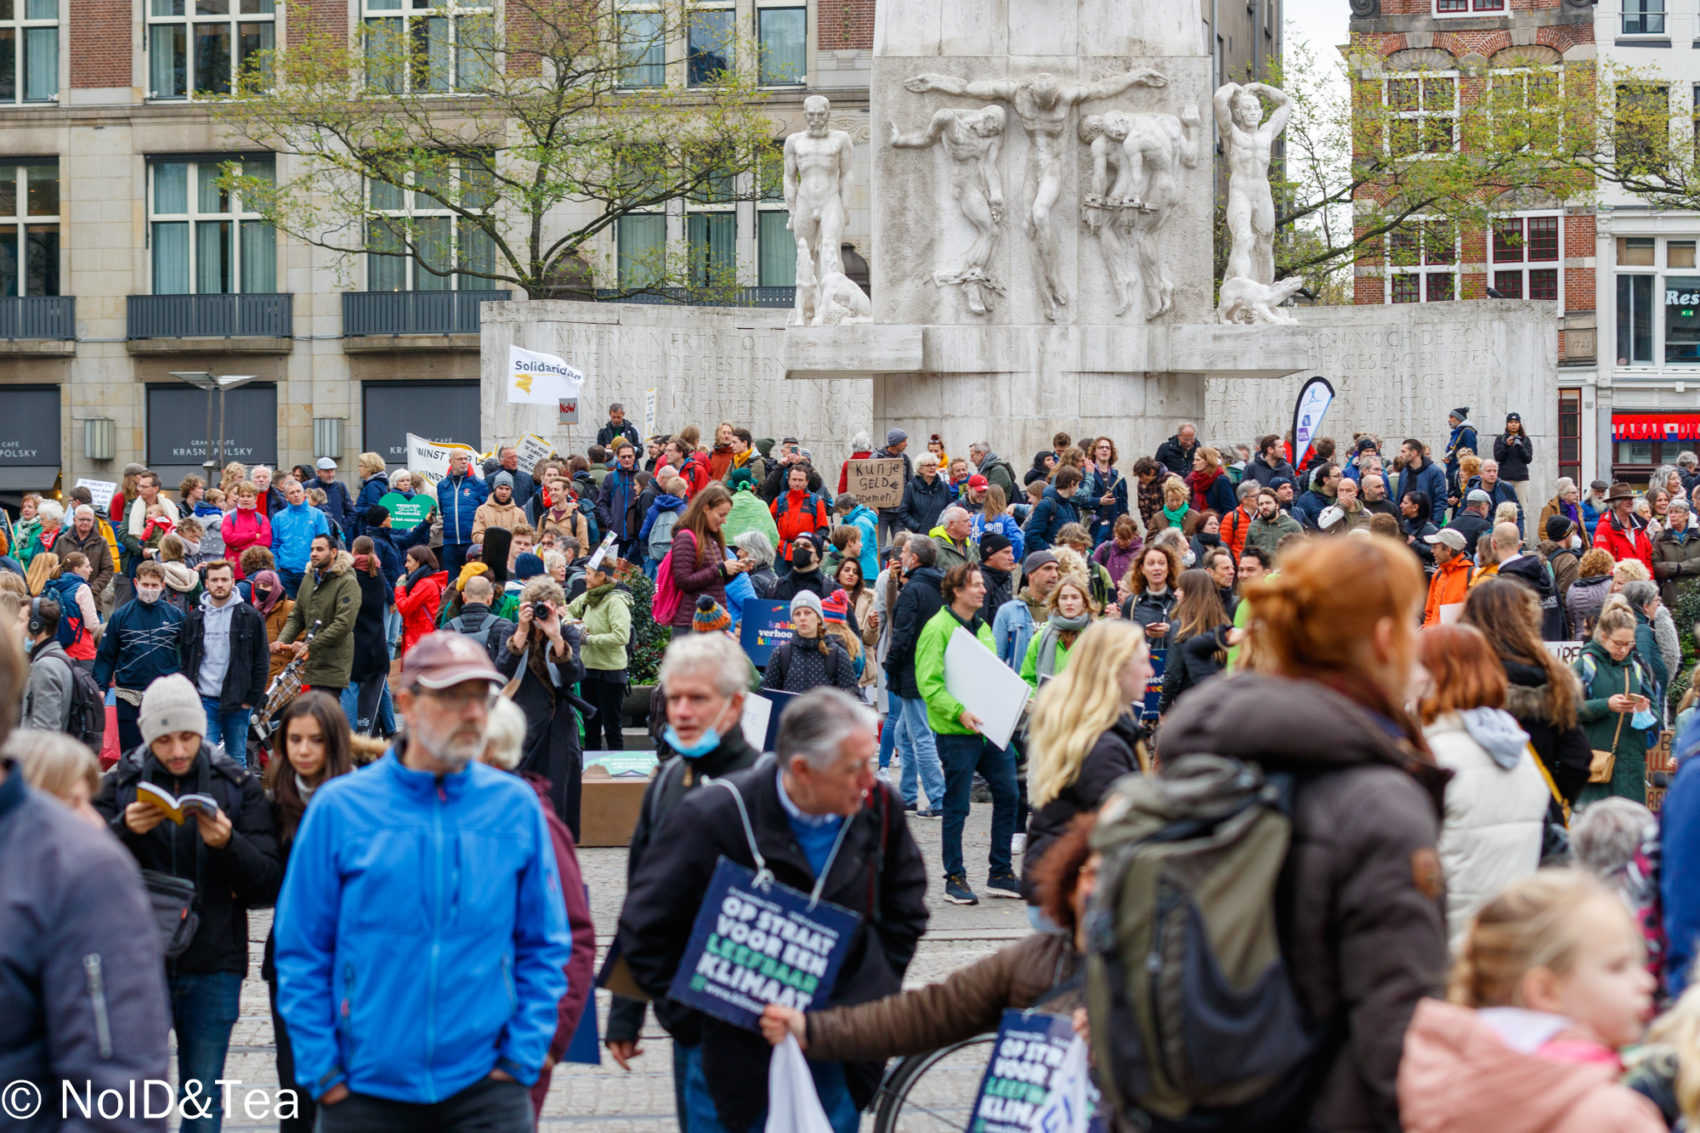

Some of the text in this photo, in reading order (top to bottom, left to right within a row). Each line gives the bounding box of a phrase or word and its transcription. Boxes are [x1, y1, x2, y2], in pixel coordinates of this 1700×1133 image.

[1664, 290, 1700, 305] Res
[1421, 329, 1444, 346] DE
[1613, 419, 1668, 440] TABAK
[172, 447, 253, 456] KRASNPLSKY
[416, 446, 447, 461] WINST
[757, 636, 791, 646] klima
[721, 896, 758, 922] OP
[756, 909, 837, 957] STRAAT
[716, 913, 784, 959] VOOR
[782, 942, 830, 978] EEN
[706, 932, 820, 996] LEEFBAAR
[695, 949, 814, 1012] KLIMAAT
